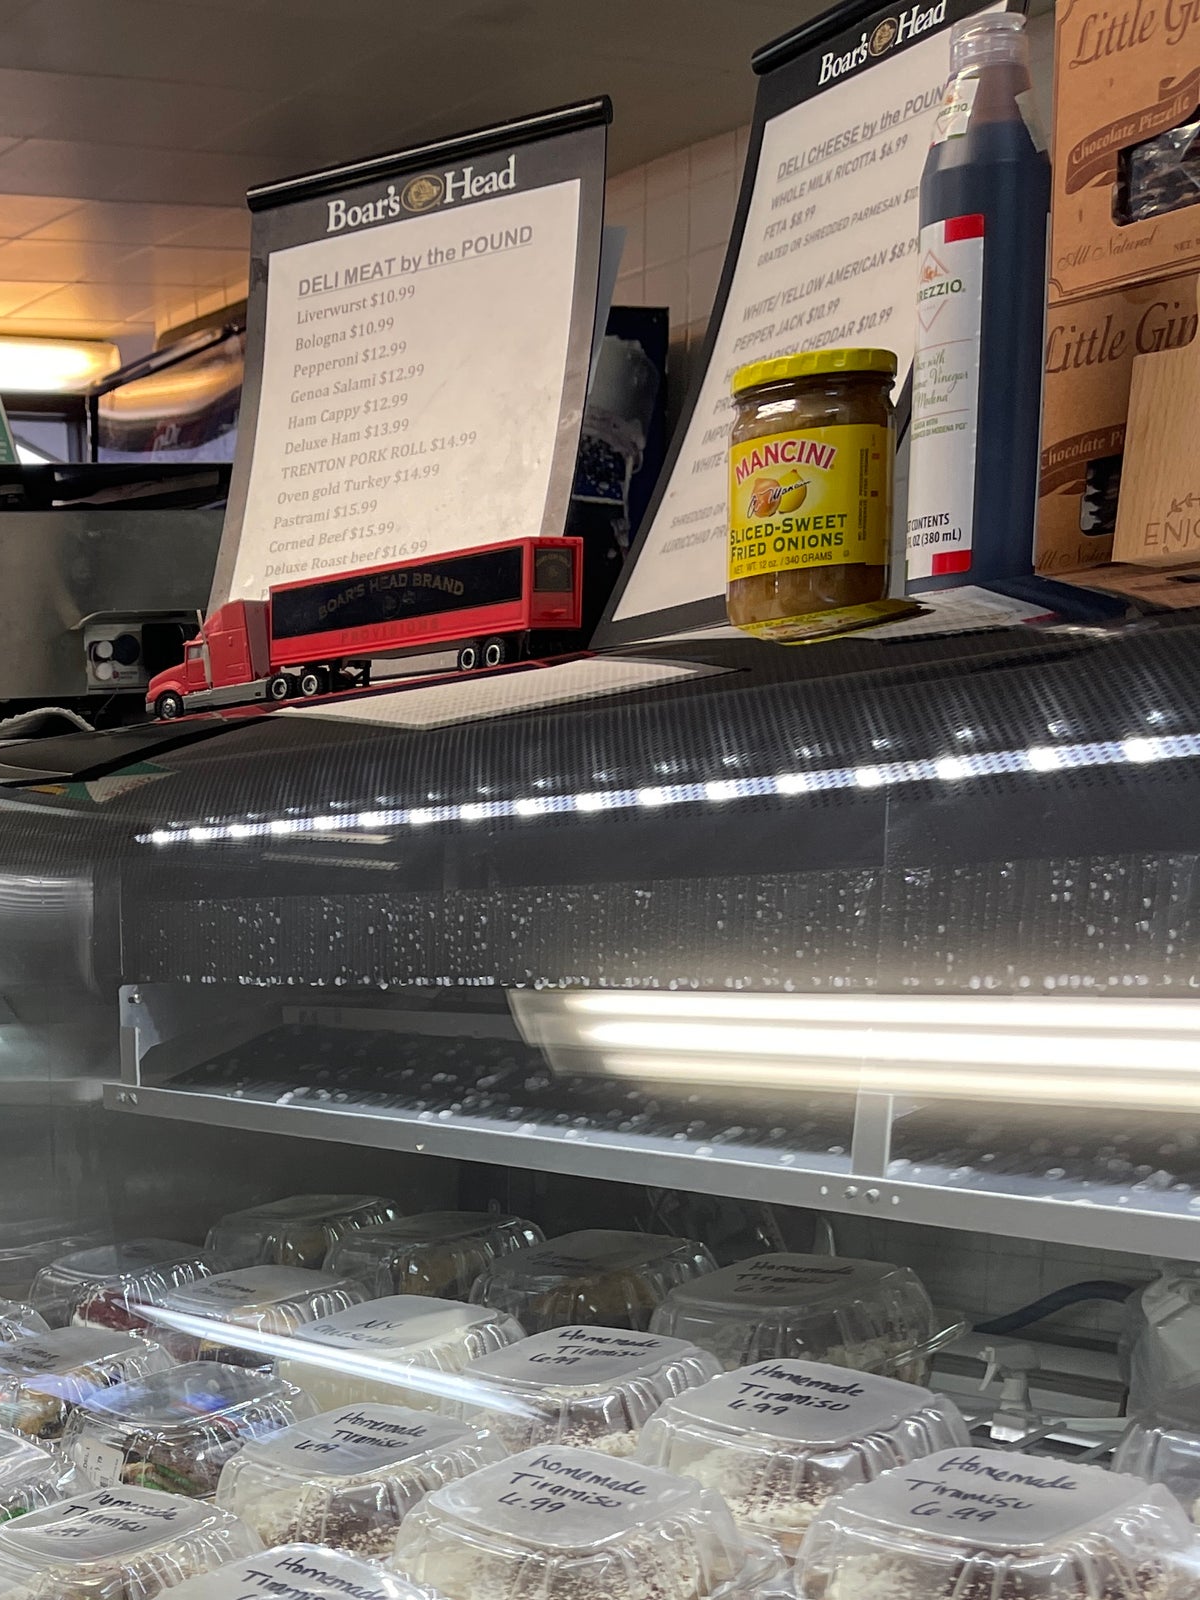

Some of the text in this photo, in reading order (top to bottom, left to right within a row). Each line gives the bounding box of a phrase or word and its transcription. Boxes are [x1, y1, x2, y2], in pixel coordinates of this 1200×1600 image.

[817, 0, 947, 87] Boar's Head
[1069, 0, 1157, 70] Little
[777, 84, 948, 180] DELI CHEESE by the POUN
[1072, 122, 1135, 166] Chocolate
[770, 134, 909, 210] WHOLE MILK RICOTTA $6.99
[326, 154, 517, 232] Boar's Head
[850, 193, 901, 225] PARMESAN
[763, 218, 787, 241] FETA
[298, 226, 533, 297] DELI MEAT by the POUND
[825, 251, 888, 288] AMERICAN
[296, 285, 416, 325] Liverwurst $10.99
[295, 317, 395, 351] Bologna $10.99
[733, 325, 775, 353] PEPPER
[776, 313, 804, 336] JACK
[801, 322, 855, 352] CHEDDAR
[1045, 313, 1126, 374] Little
[293, 341, 407, 379] Pepperoni $12.99
[290, 363, 425, 404] Genoa Salami $12.99
[287, 393, 409, 430] Ham Cappy $12.99
[281, 431, 477, 480] TRENTON PORK ROLL $14.99
[284, 418, 410, 456] Deluxe Ham $13.99
[734, 439, 838, 485] MANCINI
[277, 464, 440, 505] Oven gold Turkey $14.99
[273, 500, 378, 530] Pastrami $15.99
[912, 513, 950, 532] CONTENTS
[269, 521, 394, 554] Corned Beef $15.99
[730, 532, 844, 564] FRIED ONIONS
[921, 530, 940, 547] (380
[942, 527, 962, 543] mL)
[264, 540, 428, 578] Deluxe Roast beef $16.99
[784, 553, 799, 565] 340
[801, 551, 833, 564] GRAMS
[318, 572, 465, 619] BOAR'S HEAD BRAND
[560, 1330, 663, 1349] Homemade
[738, 1382, 849, 1411] Tiramisu
[751, 1364, 865, 1397] Homemade
[334, 1411, 428, 1437] Homemade
[510, 1472, 621, 1508] Tiramisu
[938, 1455, 1077, 1490] Homemade
[905, 1479, 1033, 1509] Tiramisu
